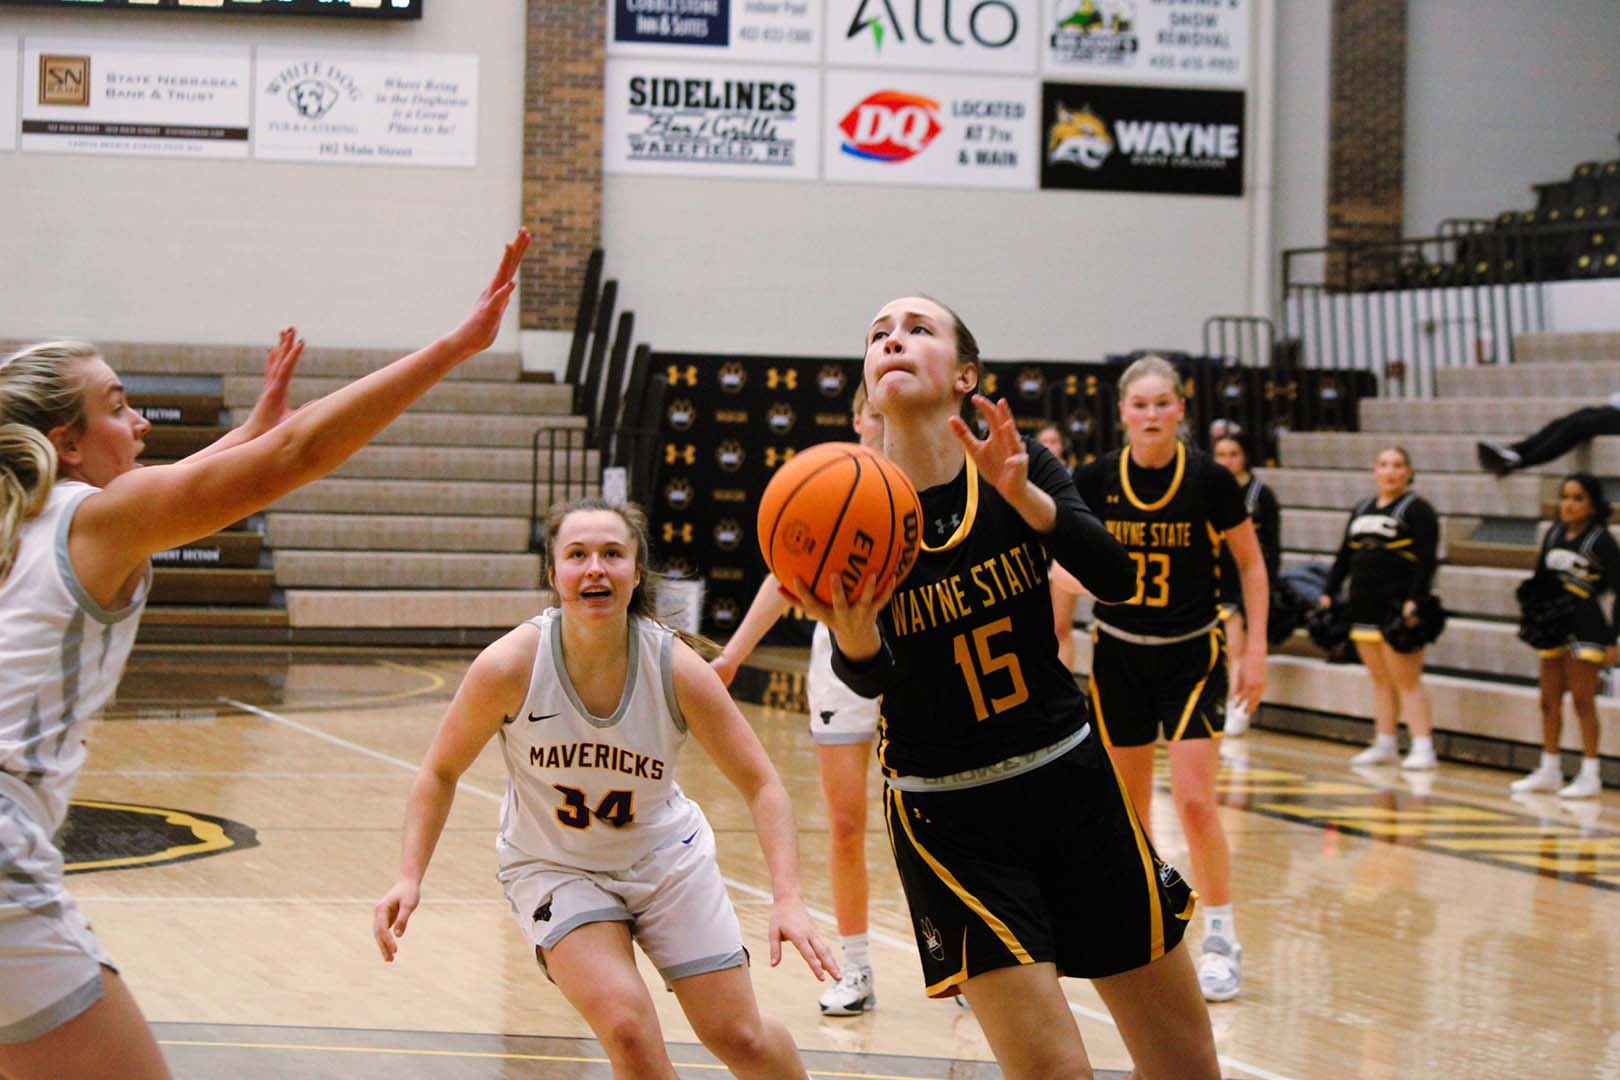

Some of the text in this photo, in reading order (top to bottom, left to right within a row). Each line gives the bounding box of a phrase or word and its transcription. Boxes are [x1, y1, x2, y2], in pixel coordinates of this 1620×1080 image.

[264, 61, 321, 96] WHITE
[629, 76, 796, 113] SIDELINES
[853, 104, 932, 151] DQ
[952, 99, 1026, 119] LOCATED
[343, 143, 375, 156] Main
[377, 145, 413, 158] Street
[966, 125, 984, 141] AT
[1114, 120, 1239, 157] WAYNE
[958, 149, 1018, 167] & MAIN
[1150, 522, 1191, 547] STATE
[890, 543, 1043, 637] WAYNE STATE
[1124, 551, 1171, 607] 33
[953, 615, 1030, 722] 15
[529, 742, 665, 780] MAVERICKS
[552, 783, 637, 832] 34
